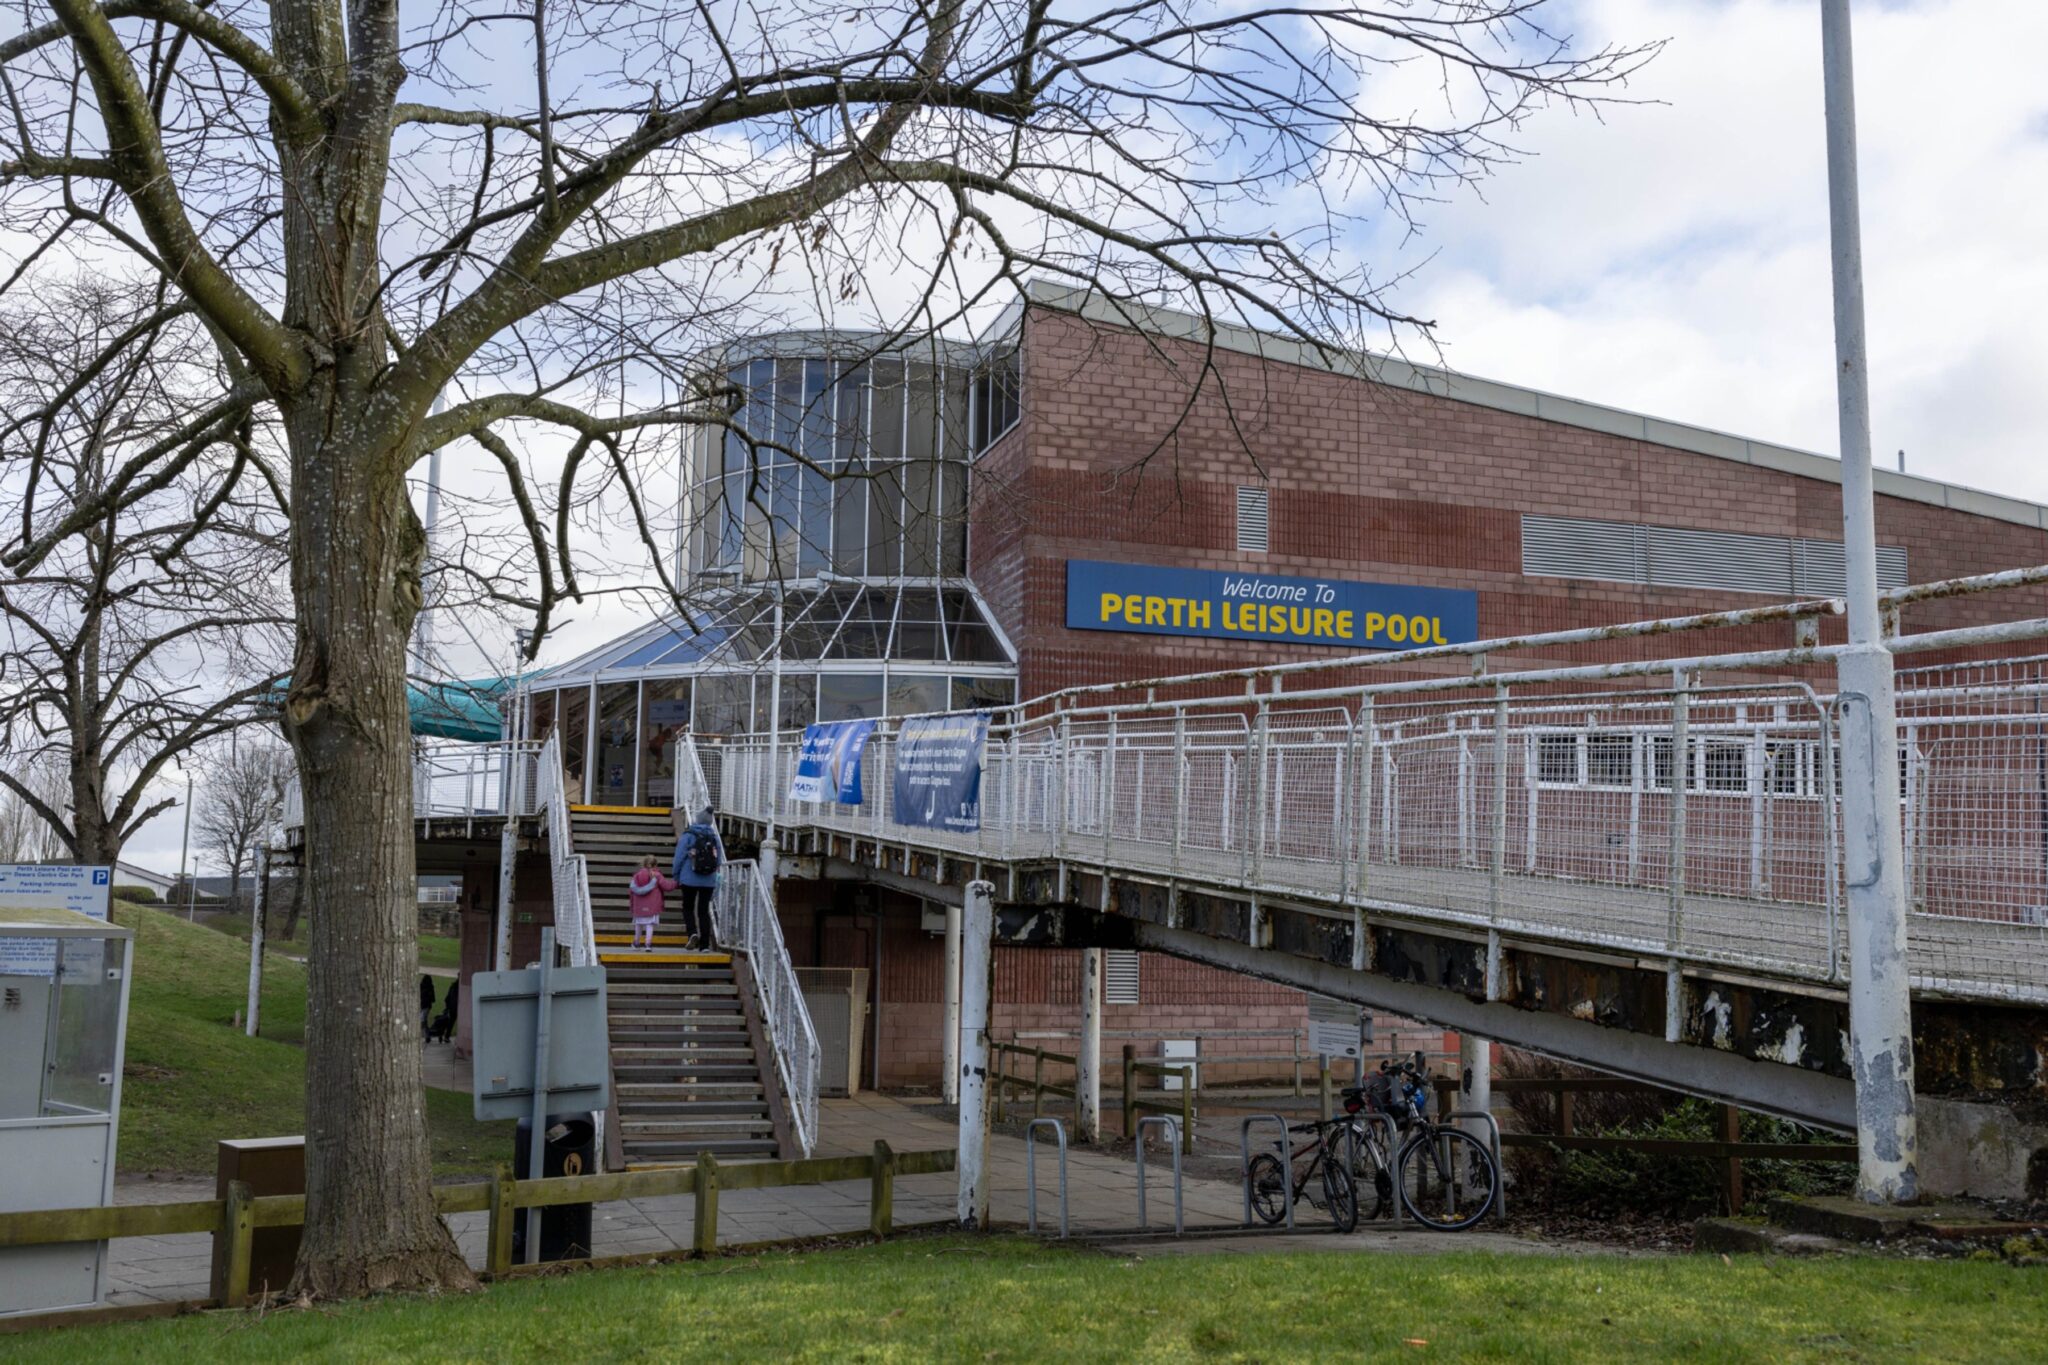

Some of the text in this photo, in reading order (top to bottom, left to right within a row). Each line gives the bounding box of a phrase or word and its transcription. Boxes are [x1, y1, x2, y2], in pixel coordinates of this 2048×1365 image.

[1222, 576, 1335, 604] Welcome To
[1100, 593, 1448, 645] PERTH LEISURE POOL
